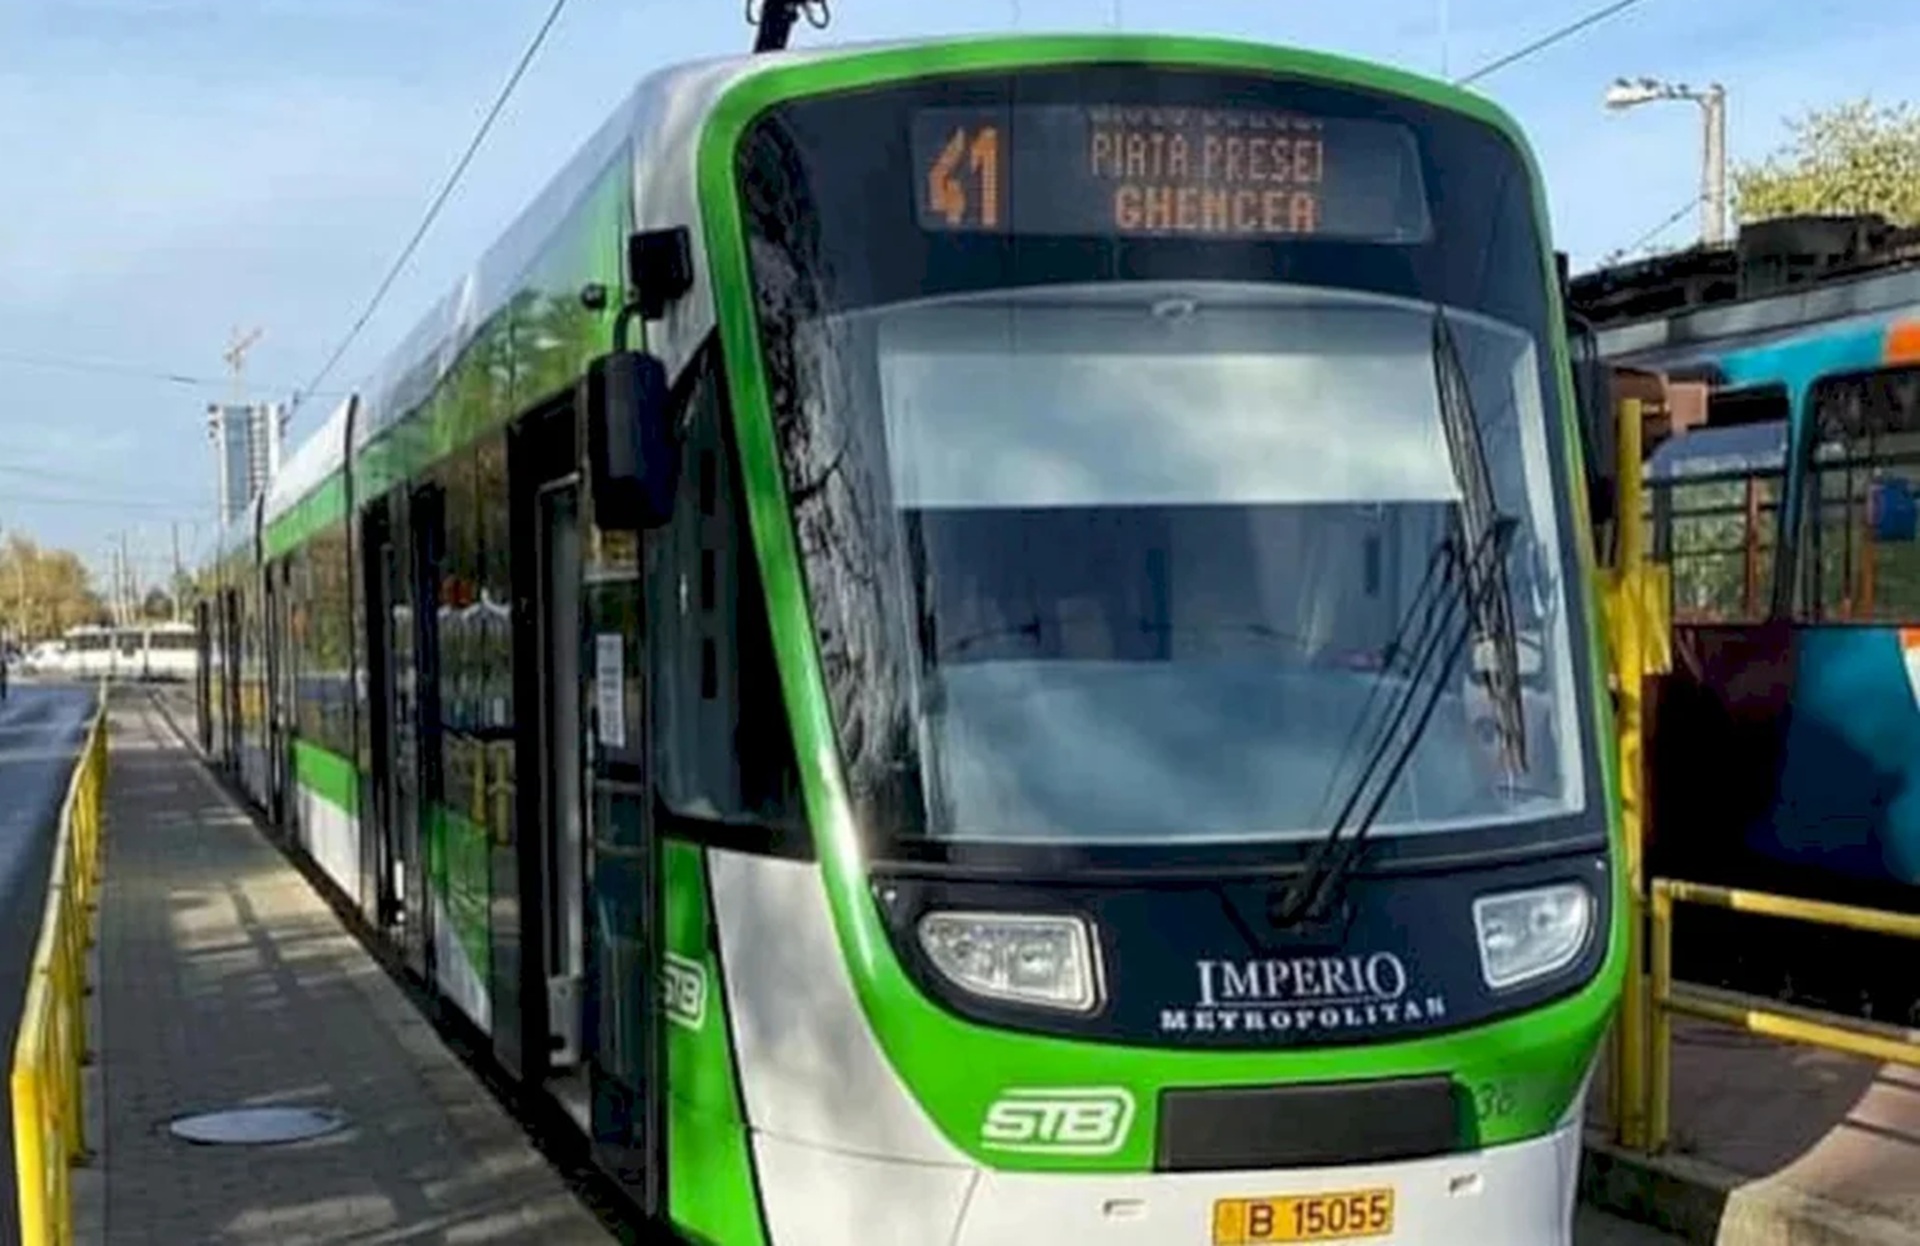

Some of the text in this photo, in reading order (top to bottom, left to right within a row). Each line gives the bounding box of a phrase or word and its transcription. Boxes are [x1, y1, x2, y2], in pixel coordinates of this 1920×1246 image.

[929, 126, 998, 227] 41
[1092, 132, 1323, 183] PIATA PRESEI
[1115, 184, 1315, 233] GHENCEA
[1197, 952, 1405, 1007] IMPERIO
[1160, 997, 1445, 1030] METROPOLITAN
[982, 1100, 1120, 1141] STB
[1250, 1194, 1387, 1237] B 15055
